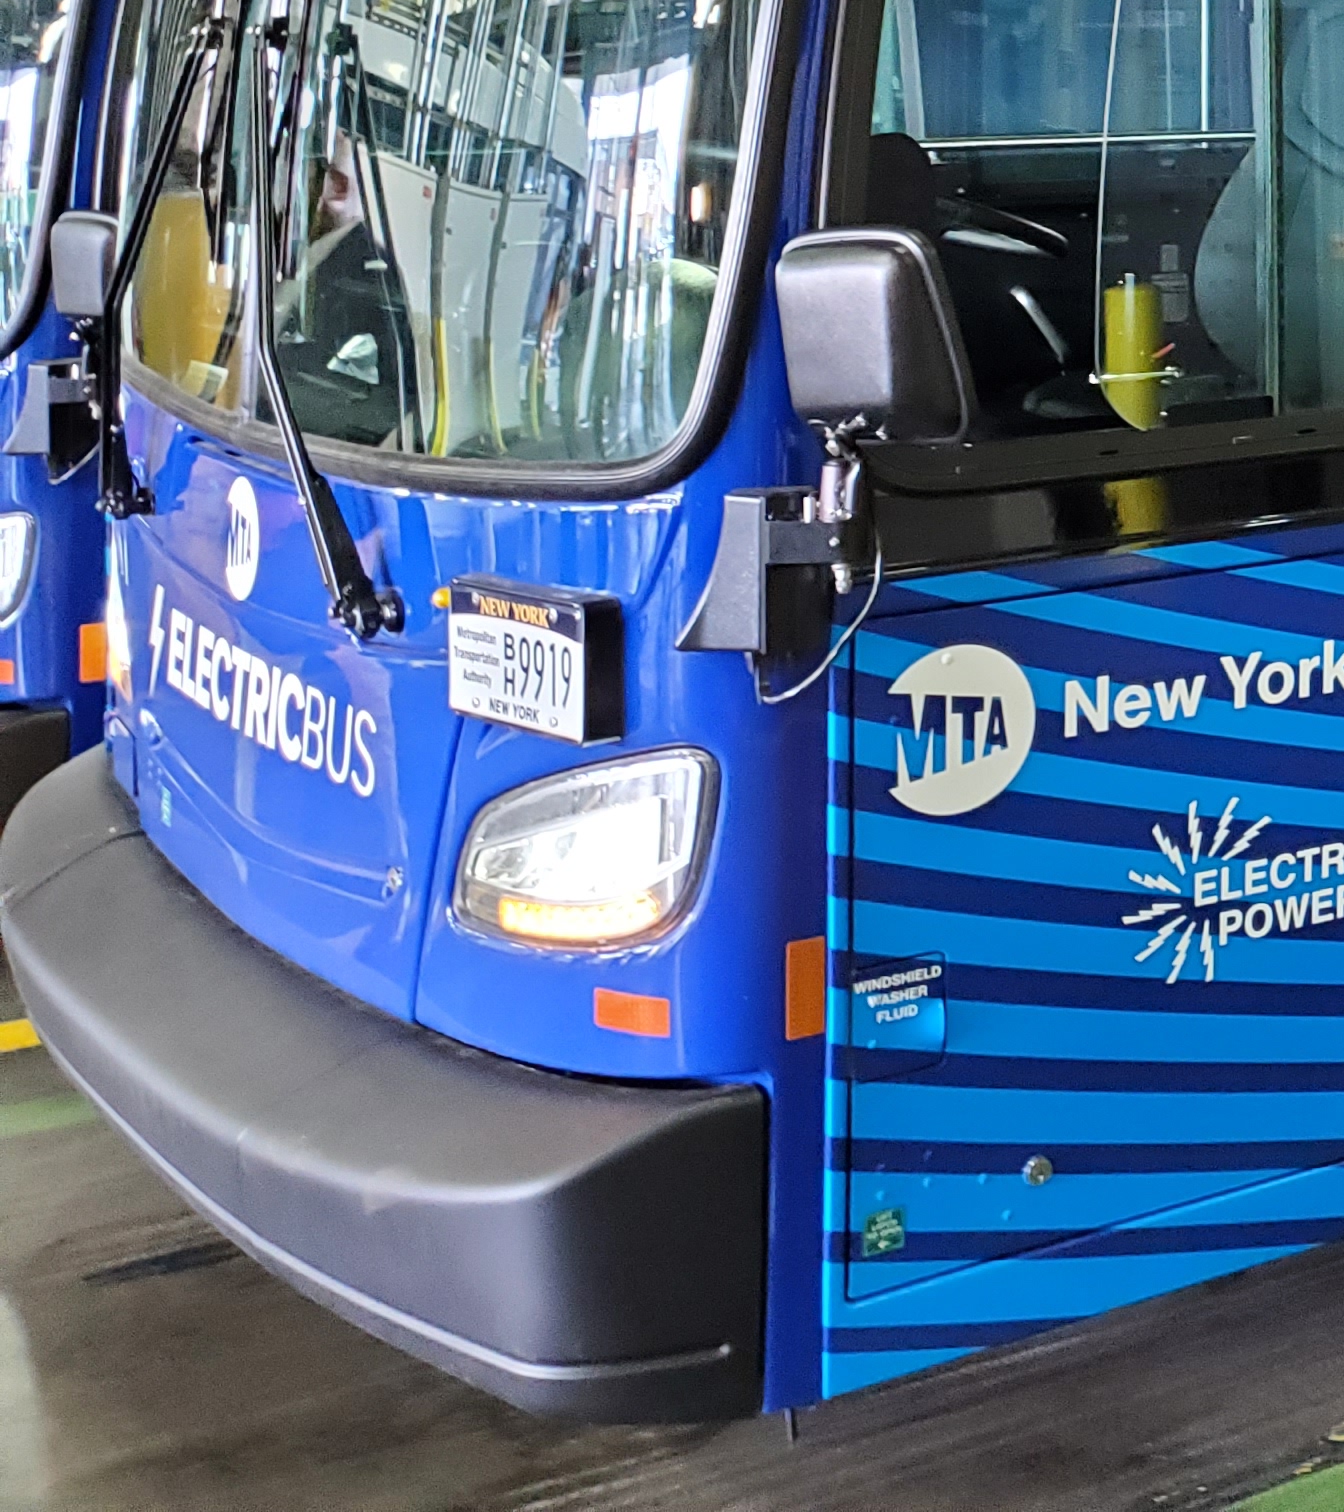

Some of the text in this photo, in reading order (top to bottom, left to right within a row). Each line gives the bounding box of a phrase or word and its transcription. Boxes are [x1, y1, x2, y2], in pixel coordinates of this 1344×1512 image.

[479, 594, 550, 628] NEW YORK
[519, 636, 572, 709] 9919
[489, 697, 540, 724] NEW YORK
[1063, 674, 1207, 738] New
[852, 964, 943, 995] WINDSHIELD
[867, 984, 928, 1008] WASHER
[876, 1003, 919, 1024] FLUID
